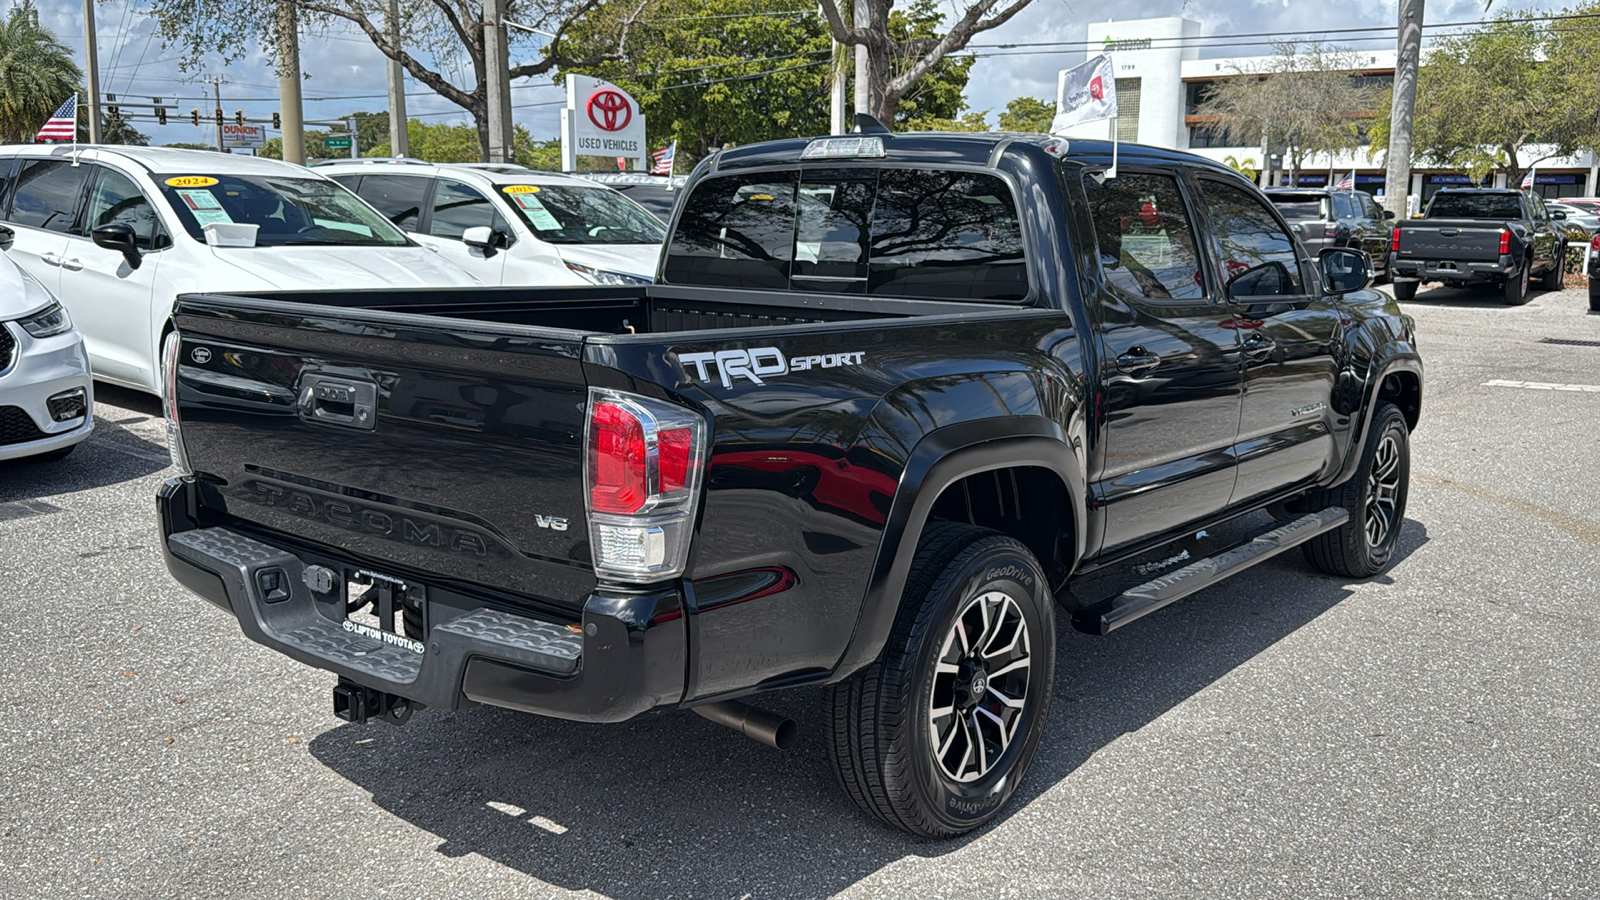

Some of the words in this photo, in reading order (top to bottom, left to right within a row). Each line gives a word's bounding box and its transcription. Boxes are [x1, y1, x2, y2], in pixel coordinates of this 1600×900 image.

[579, 138, 601, 149] USED
[603, 139, 638, 151] VEHICLES
[175, 178, 208, 186] 2024
[1414, 242, 1483, 250] TACOMA
[677, 346, 789, 390] TRD
[790, 351, 866, 372] SPORT
[316, 386, 349, 402] TOYOTA
[255, 482, 487, 557] TACOMA
[534, 514, 569, 531] V6
[986, 565, 1033, 586] GeoDrive
[354, 623, 382, 640] LIPTON
[382, 632, 414, 650] TOYOTA
